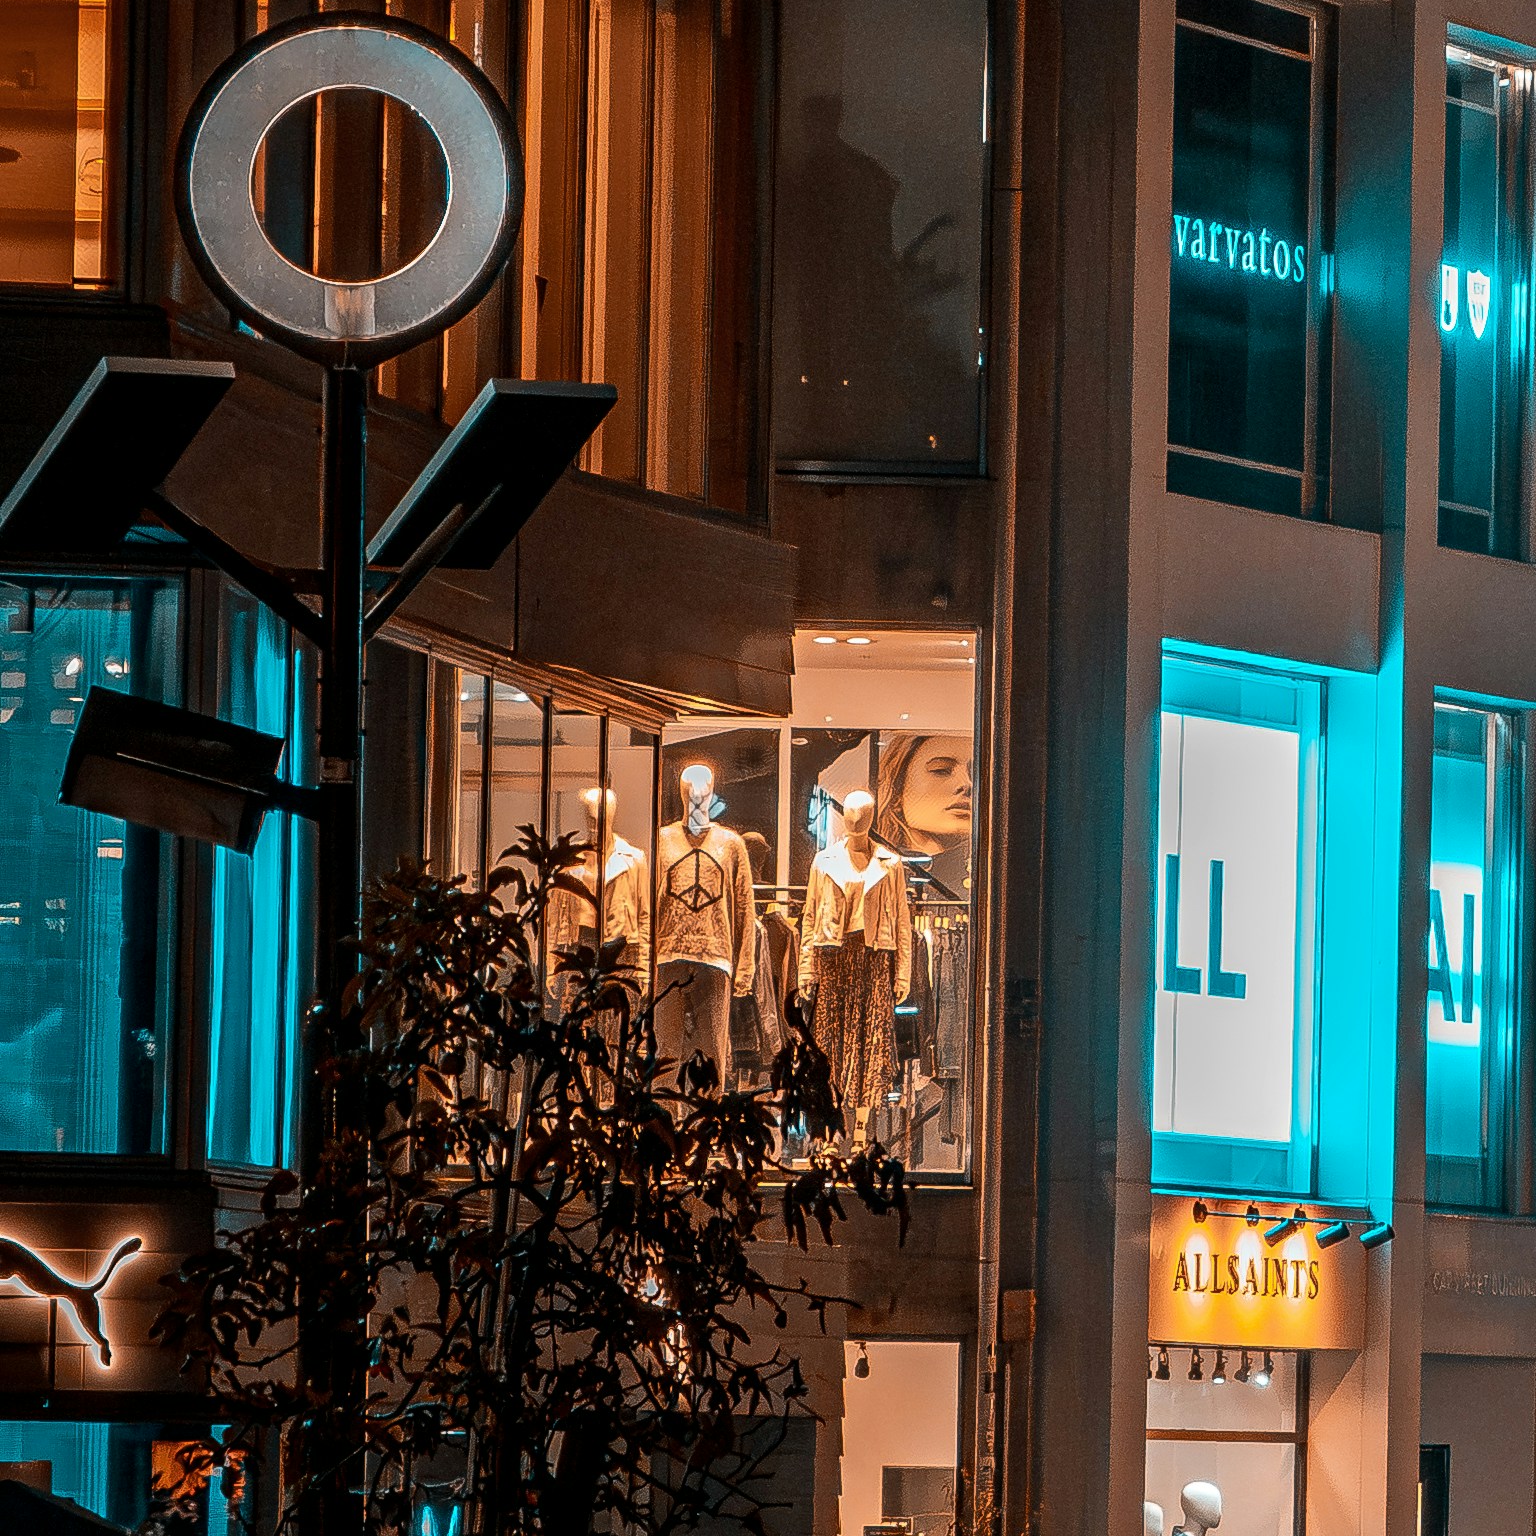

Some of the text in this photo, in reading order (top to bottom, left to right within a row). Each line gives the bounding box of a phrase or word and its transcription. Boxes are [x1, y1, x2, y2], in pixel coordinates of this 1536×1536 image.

[1173, 214, 1306, 283] varvatos
[1157, 854, 1246, 1000] LL
[1172, 1252, 1320, 1301] ALLSAINTS
